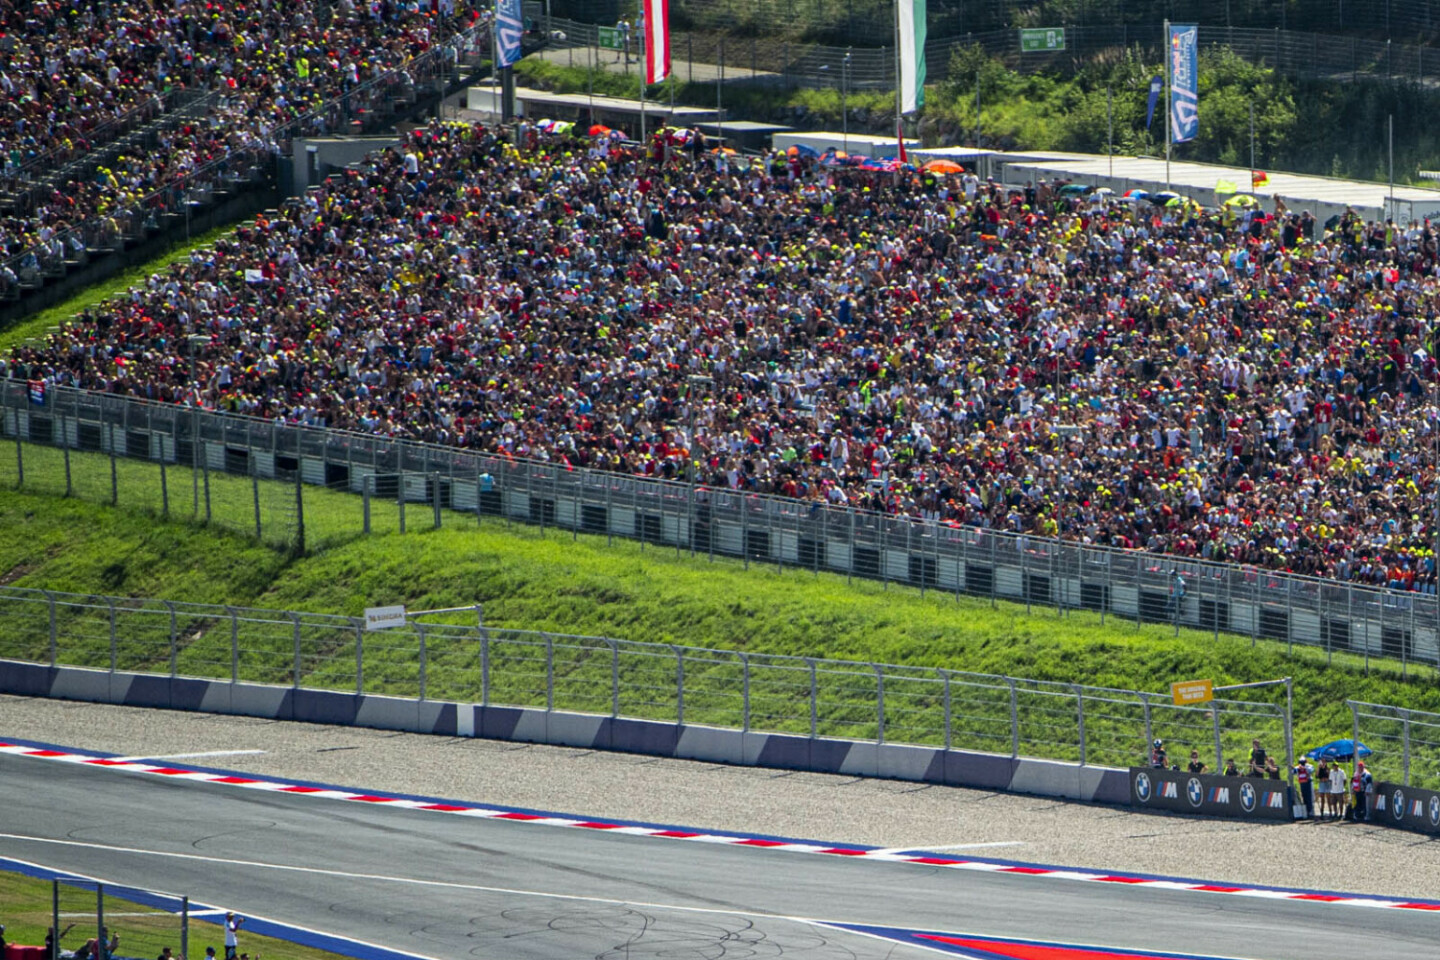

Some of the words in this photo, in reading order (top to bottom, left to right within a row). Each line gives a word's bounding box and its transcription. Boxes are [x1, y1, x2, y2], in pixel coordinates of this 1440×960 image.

[1163, 782, 1177, 798] M
[1216, 787, 1229, 803] M
[1269, 792, 1282, 808] M
[1374, 794, 1385, 810] M
[1412, 800, 1422, 817] M
